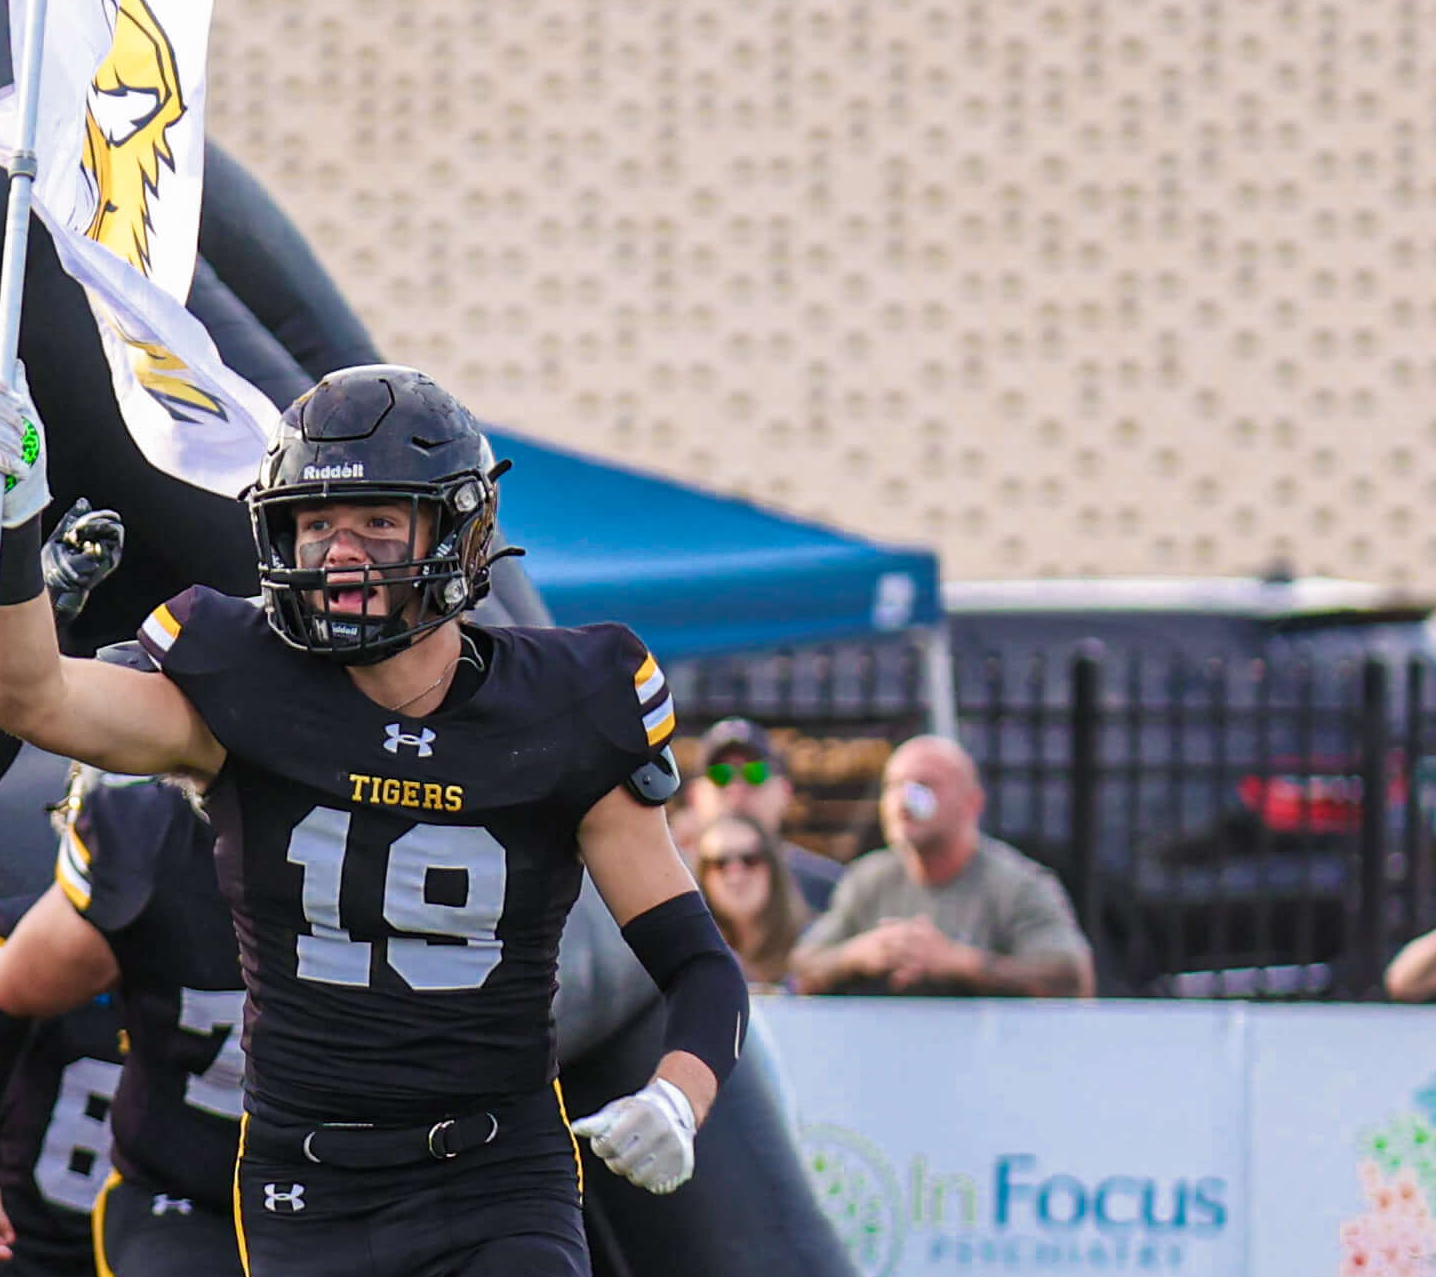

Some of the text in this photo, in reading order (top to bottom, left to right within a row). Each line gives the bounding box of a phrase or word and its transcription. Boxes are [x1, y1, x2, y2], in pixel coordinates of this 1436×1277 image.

[303, 463, 364, 481] Riddell
[349, 772, 465, 813] TIGERS
[286, 805, 508, 991] 19
[994, 1152, 1227, 1237] Focus
